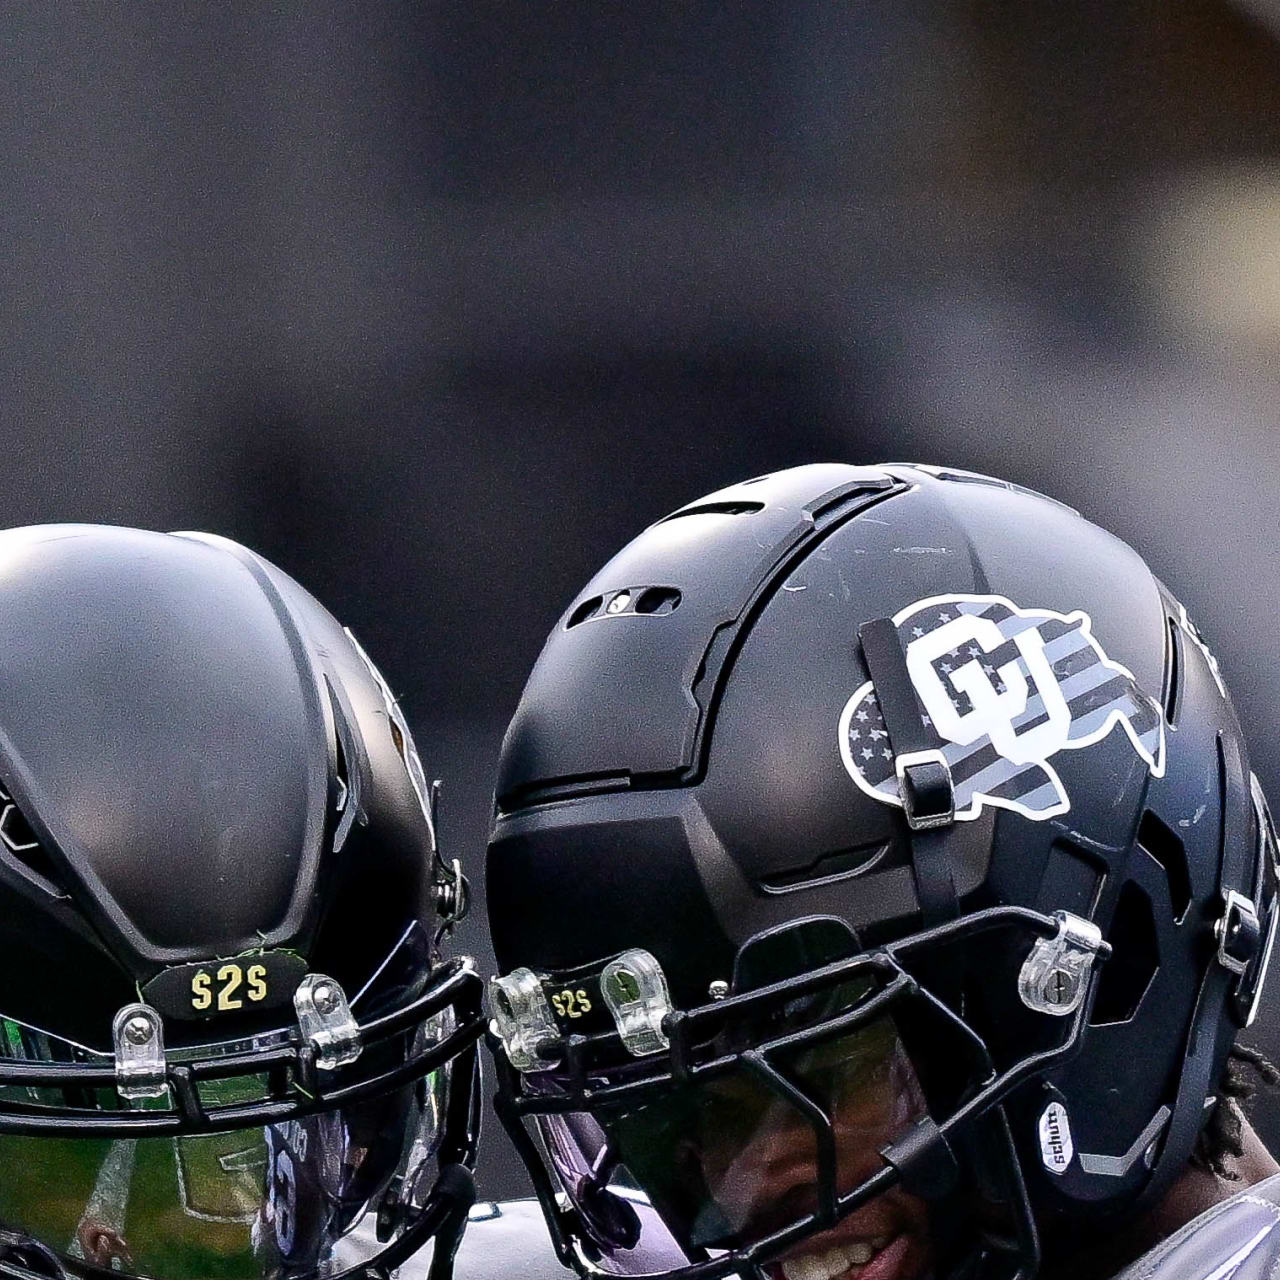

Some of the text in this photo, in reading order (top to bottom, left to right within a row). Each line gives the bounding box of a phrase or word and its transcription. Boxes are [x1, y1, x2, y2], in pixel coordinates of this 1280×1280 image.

[907, 613, 1072, 766] CU
[191, 963, 268, 1011] S2S
[551, 989, 592, 1018] S2S
